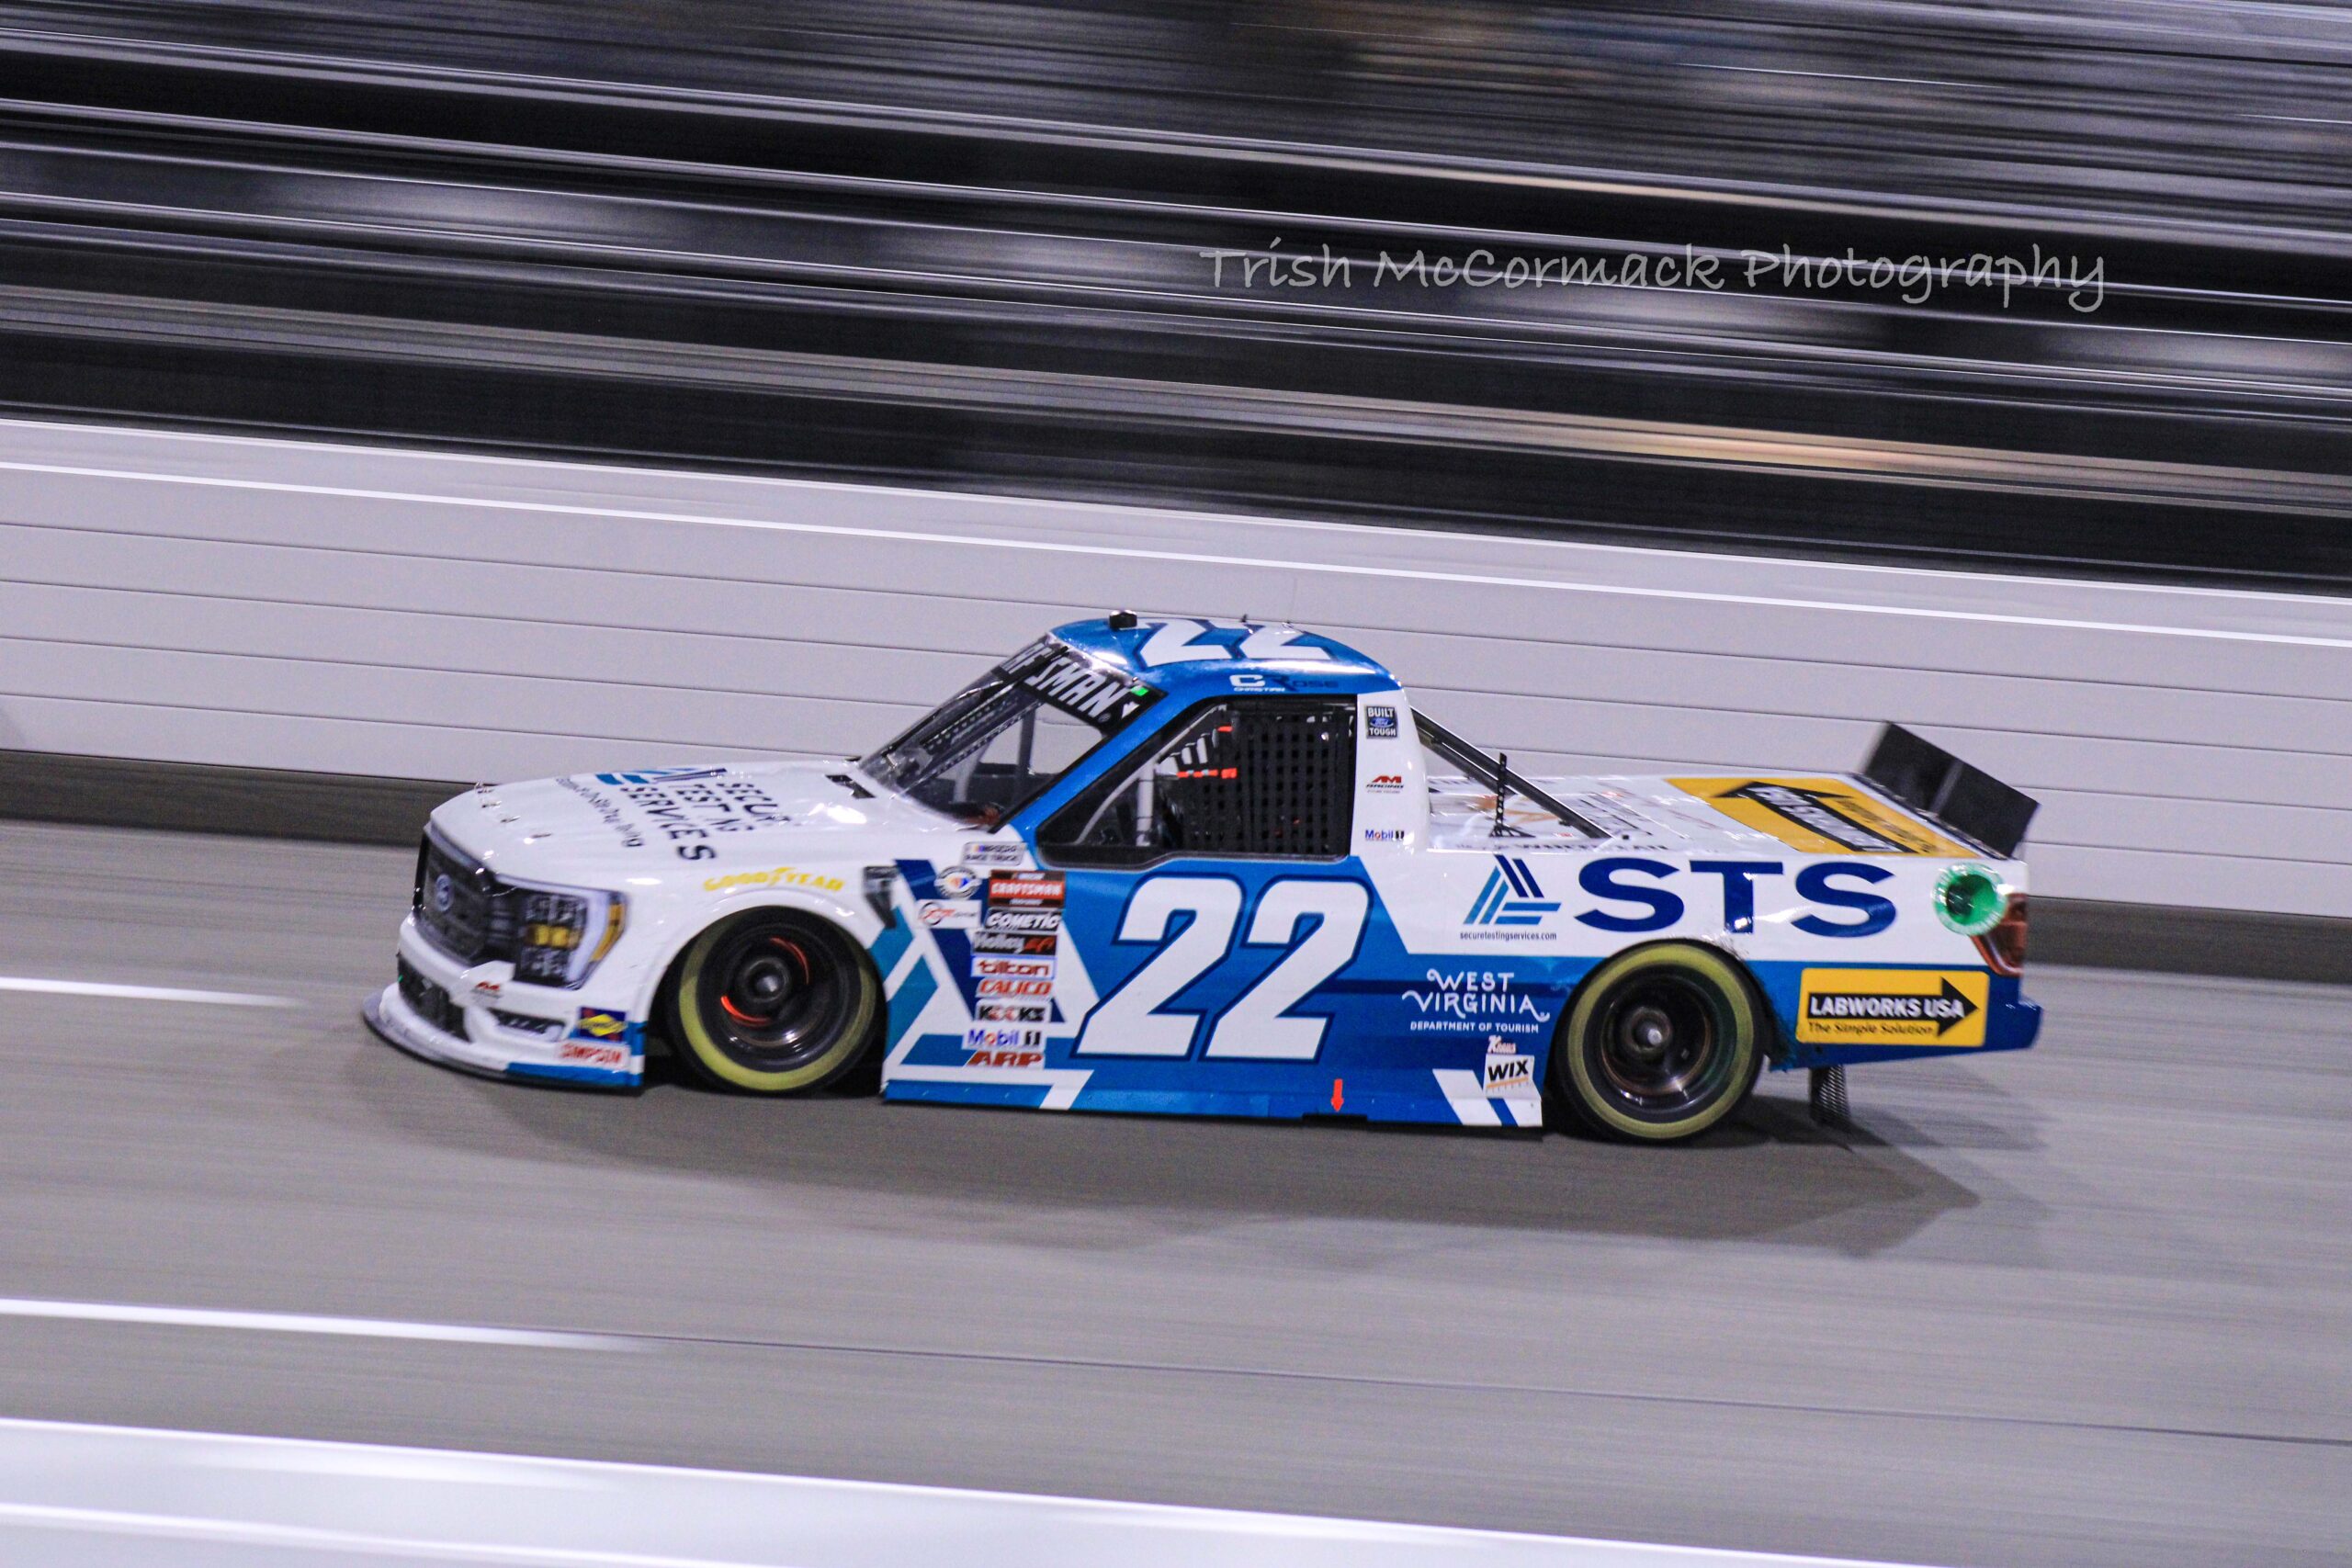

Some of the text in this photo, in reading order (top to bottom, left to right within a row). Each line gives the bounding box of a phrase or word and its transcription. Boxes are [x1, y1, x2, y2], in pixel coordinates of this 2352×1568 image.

[1114, 617, 1331, 668] 22
[1367, 707, 1396, 717] BUILT
[1369, 728, 1397, 737] TOUGH
[1364, 829, 1394, 840] Mobil
[1574, 857, 1897, 939] STS
[1460, 931, 1557, 942] securetestingservices.com
[1072, 874, 1372, 1062] 22
[1426, 968, 1515, 993] WEST
[1401, 989, 1551, 1023] VIRGINIA
[1810, 996, 1965, 1019] LABWORKS USA
[1410, 1021, 1539, 1033] DEPARTMENT OF TOURISM
[1808, 1021, 1831, 1034] The
[968, 1029, 1019, 1046] Mobil
[967, 1050, 1044, 1066] ARP
[1487, 1058, 1529, 1082] WIX
